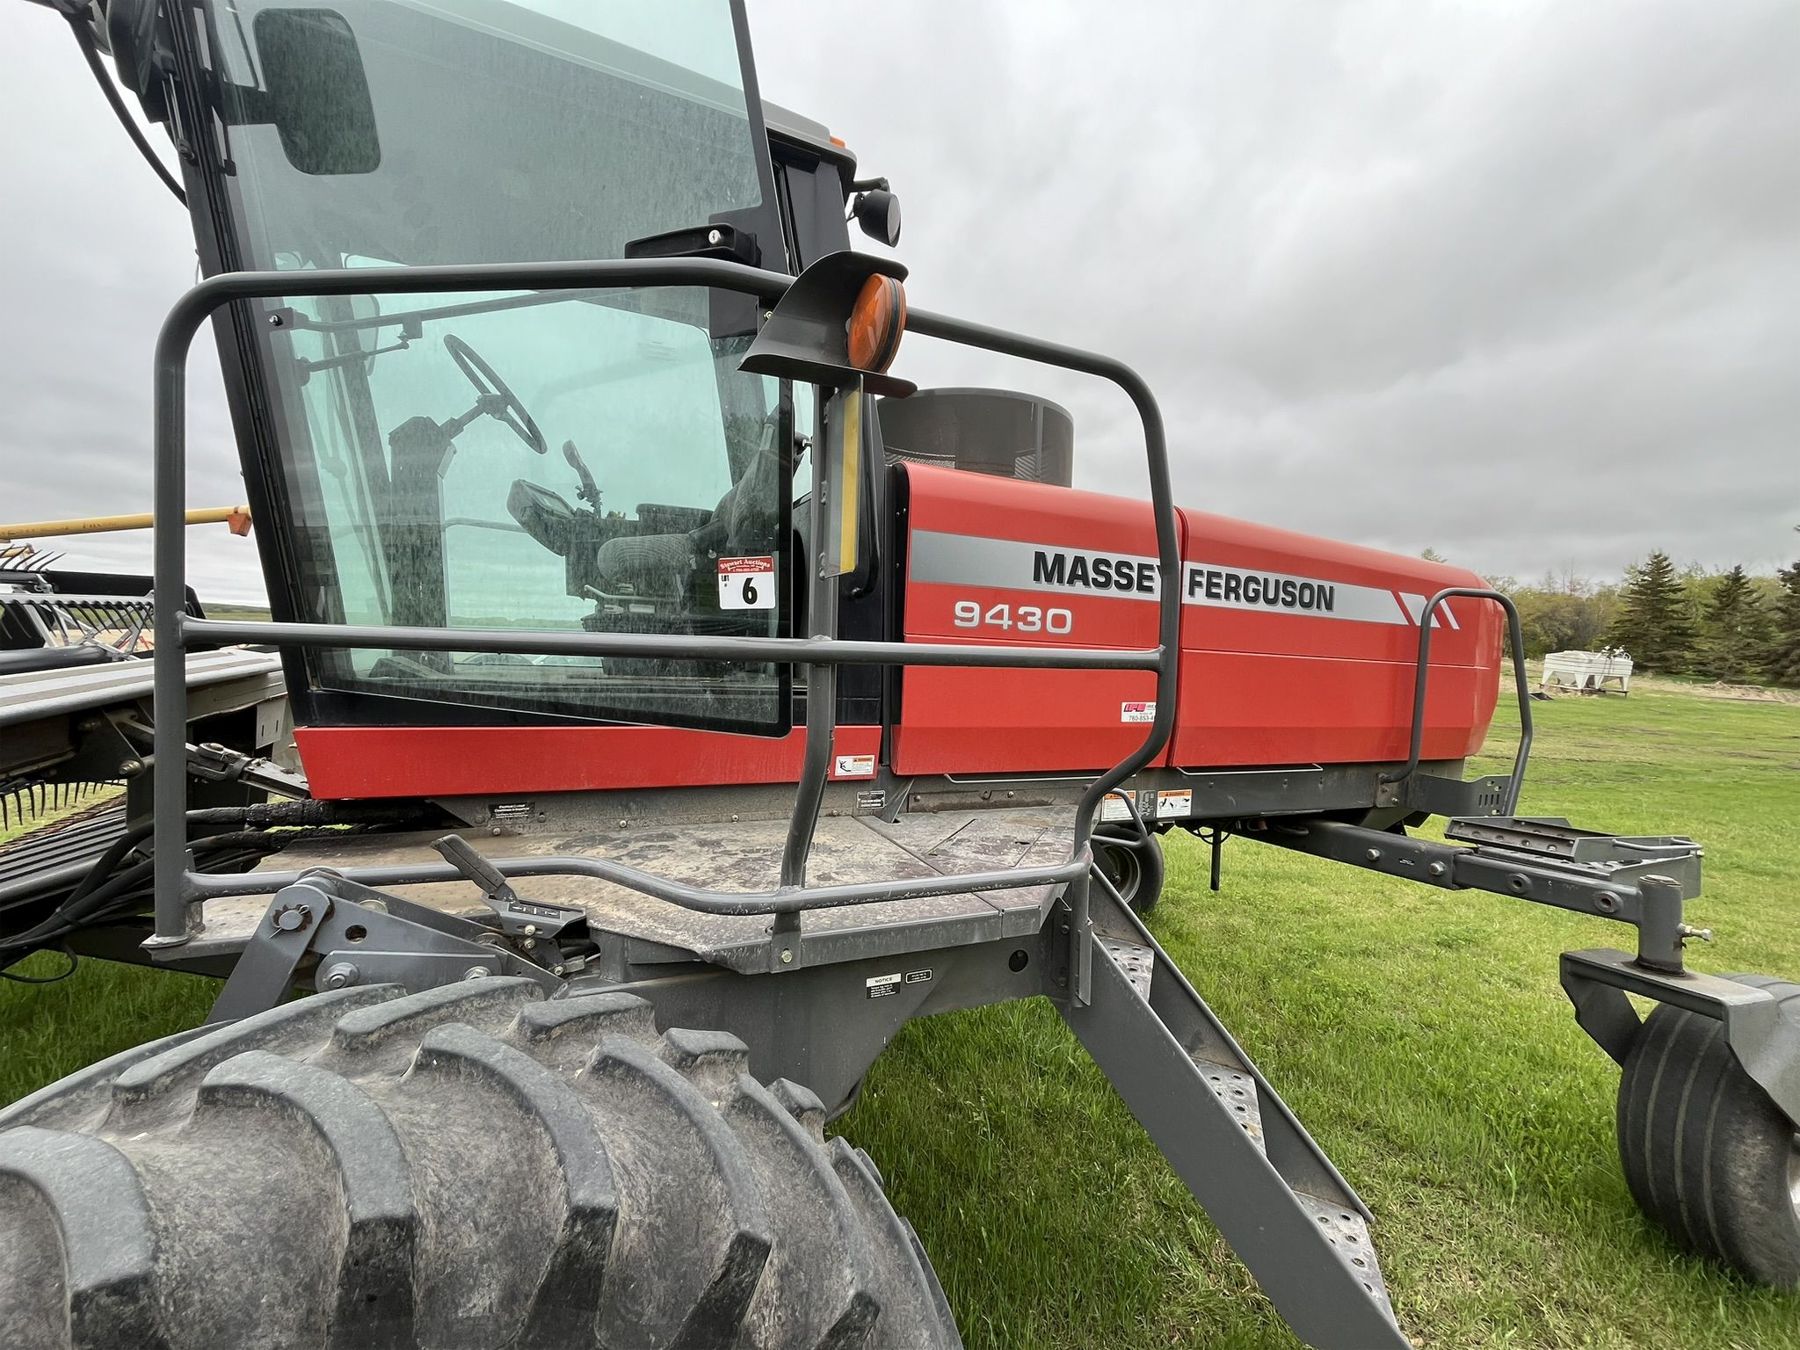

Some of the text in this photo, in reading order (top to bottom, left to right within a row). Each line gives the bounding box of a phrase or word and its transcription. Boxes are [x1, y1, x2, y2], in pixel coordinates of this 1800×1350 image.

[744, 559, 770, 568] Auctions
[742, 577, 758, 605] 6
[1188, 568, 1335, 611] FERGUSON
[954, 600, 1073, 634] 9430
